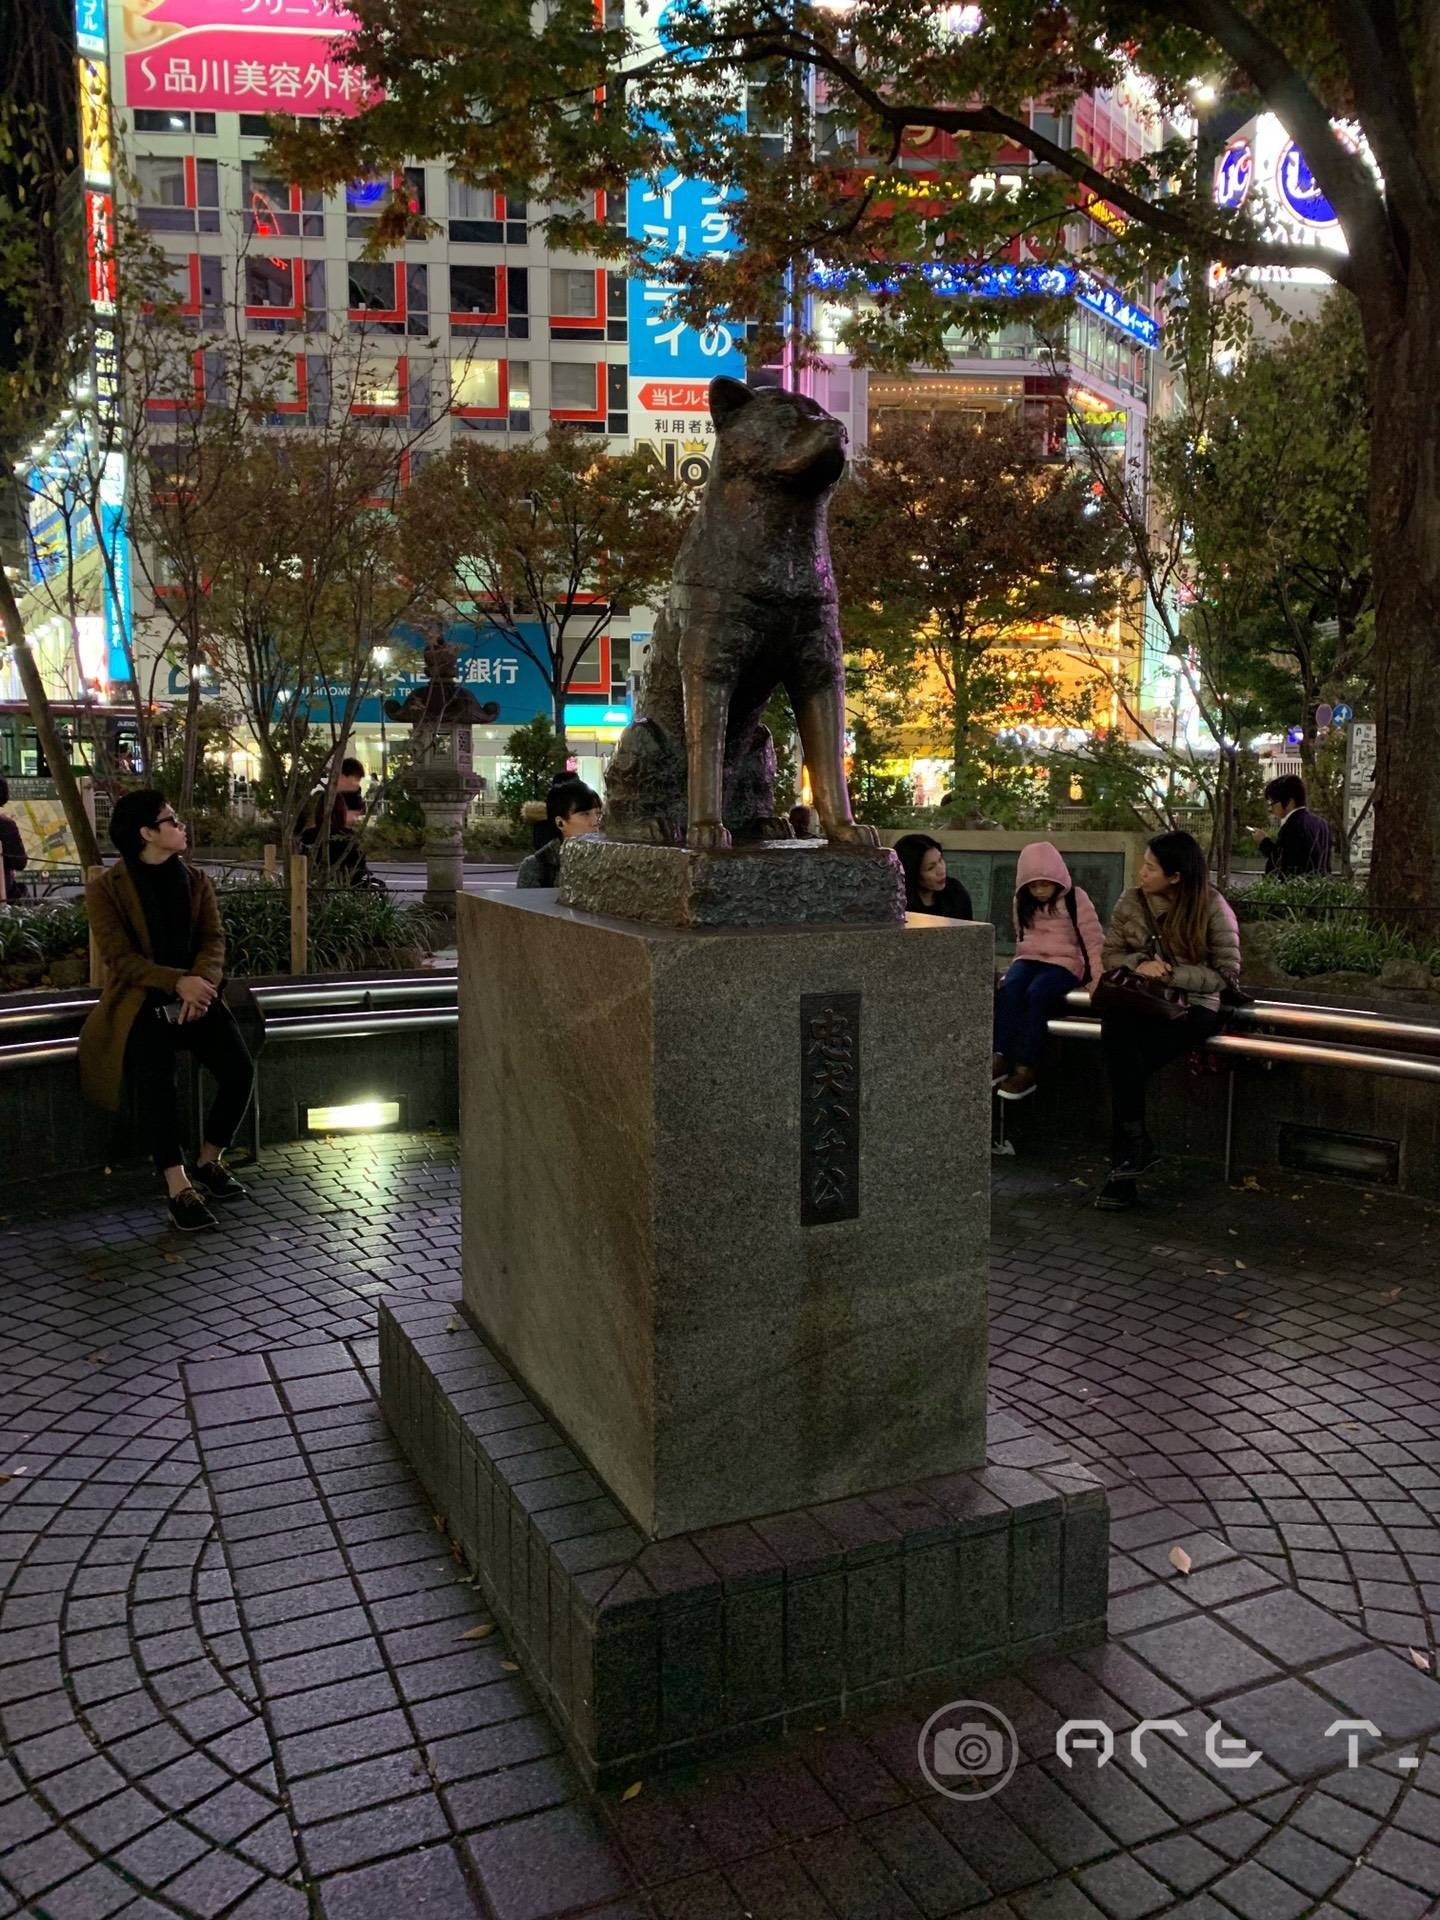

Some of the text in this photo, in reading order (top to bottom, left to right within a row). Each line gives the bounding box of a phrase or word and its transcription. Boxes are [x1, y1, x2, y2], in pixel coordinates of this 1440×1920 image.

[164, 57, 370, 100] 品川美容外科
[969, 172, 1034, 203] ガス
